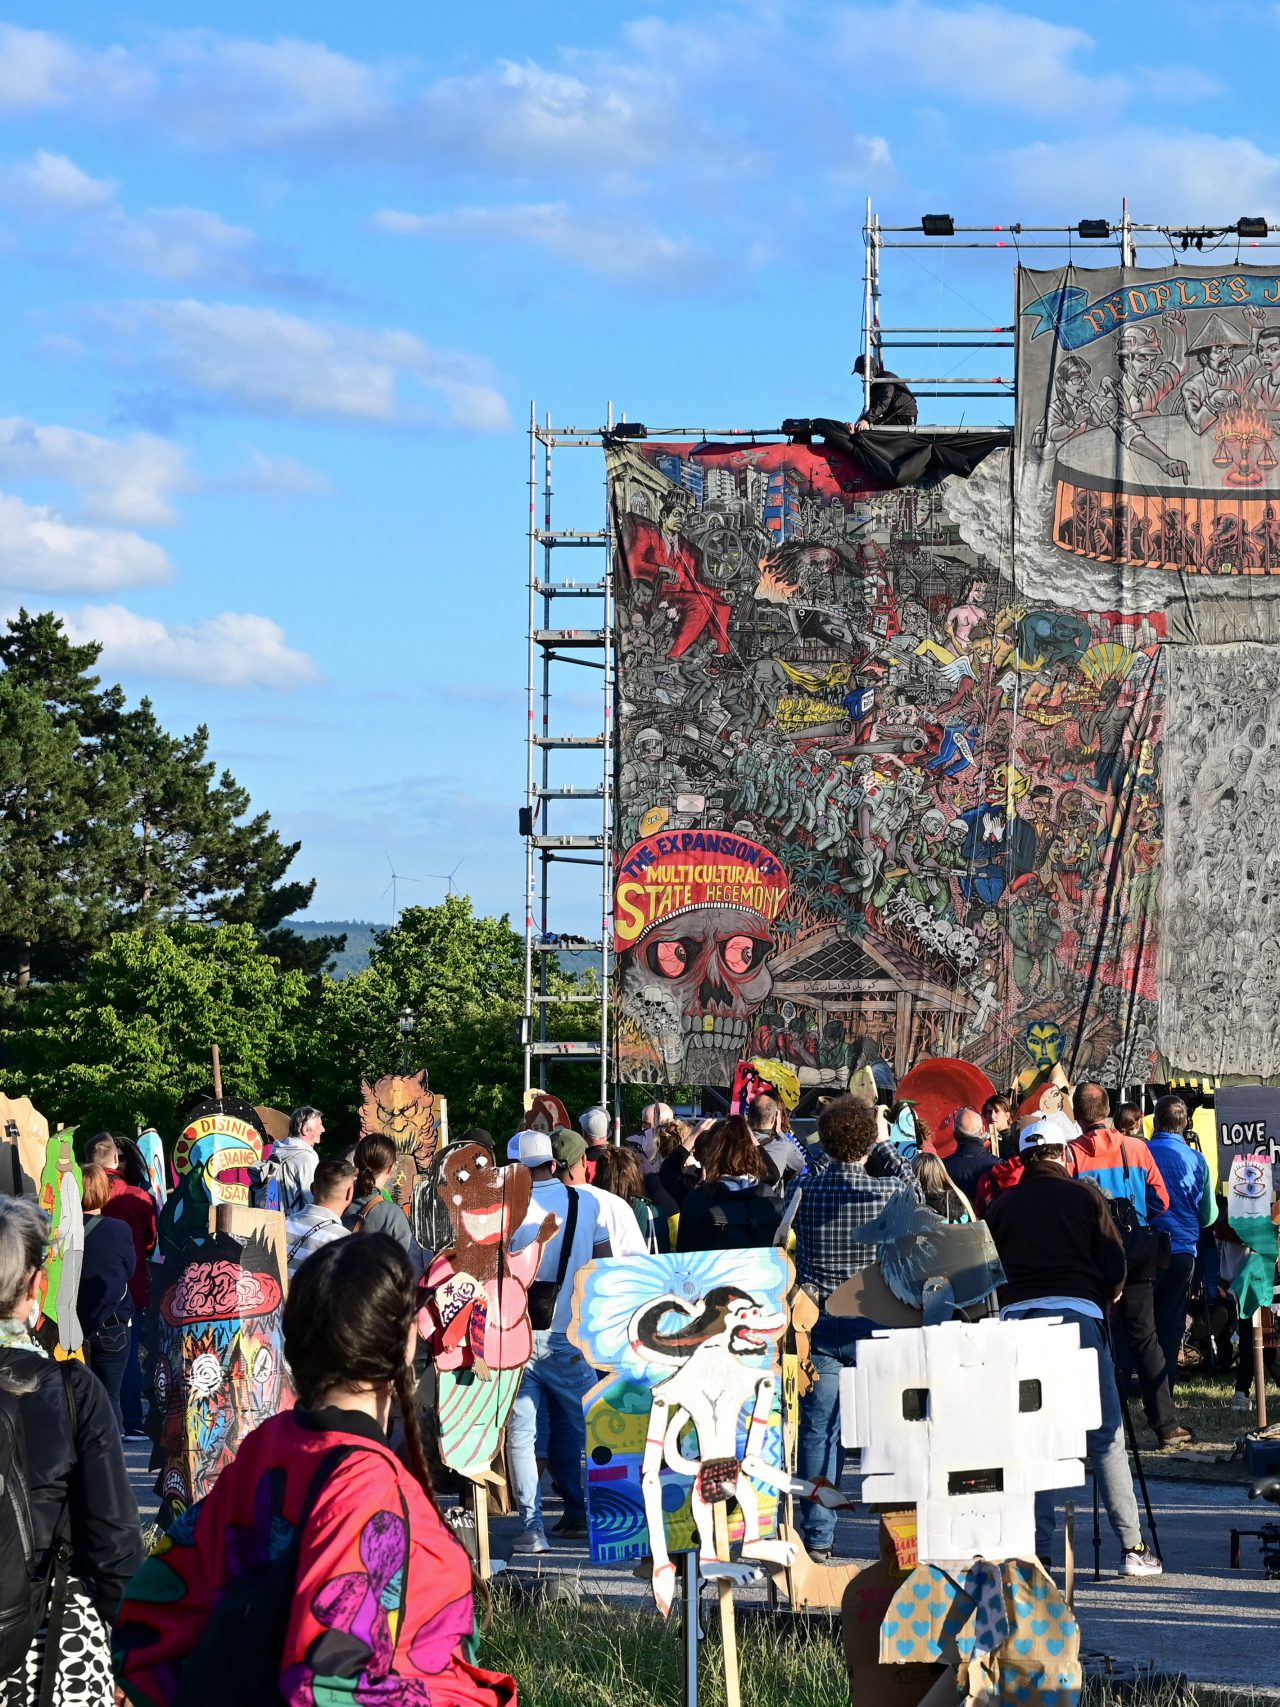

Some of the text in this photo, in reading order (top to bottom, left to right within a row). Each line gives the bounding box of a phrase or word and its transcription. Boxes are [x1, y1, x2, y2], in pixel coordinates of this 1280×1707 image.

[1082, 276, 1250, 334] PEOPLE'S
[622, 832, 782, 879] THE EXPANSION OF
[614, 882, 788, 941] STATE HEGEMONY
[200, 1118, 247, 1137] DISINI
[1220, 1121, 1266, 1145] LOVE
